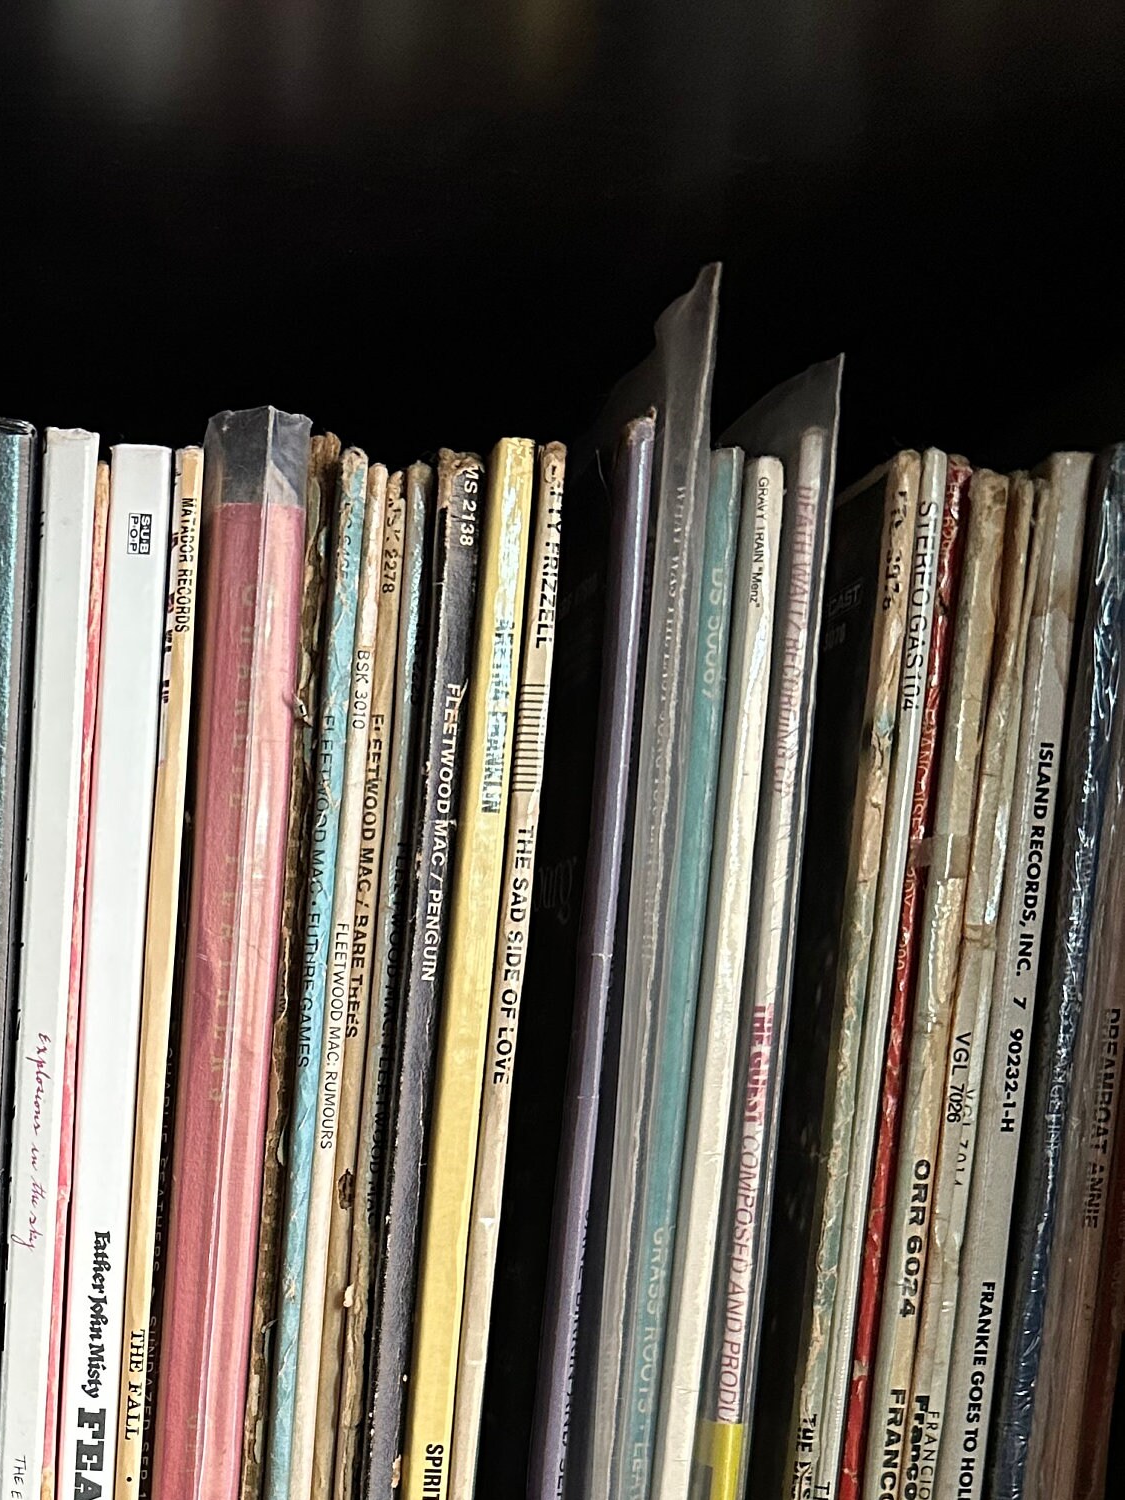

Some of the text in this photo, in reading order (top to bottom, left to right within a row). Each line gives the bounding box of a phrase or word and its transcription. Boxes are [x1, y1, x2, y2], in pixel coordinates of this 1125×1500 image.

[175, 497, 197, 632] MATADOR RECORDS
[356, 651, 371, 683] BSK
[352, 691, 369, 729] 3010
[421, 499, 477, 981] 2138 FLEETWOOD MAC PENGUIN
[1000, 742, 1055, 1133] ISLAND RECORDS, INC. 7 90232-1-H
[328, 923, 351, 1020] FLEETWOOD
[326, 1027, 341, 1066] MAC:
[946, 1031, 971, 1123] VGL 7026
[319, 1071, 339, 1149] RUMOURS
[11, 1033, 50, 1252] Explosions in the sky
[93, 1231, 111, 1294] Father
[899, 1160, 931, 1317] ORR 6024
[88, 1296, 109, 1341] John
[972, 1281, 997, 1366] FRANKIE
[82, 1343, 106, 1399] Misty
[129, 1329, 145, 1372] THE
[124, 1381, 142, 1441] FALL
[966, 1371, 985, 1423] GOES
[963, 1428, 979, 1452] TO
